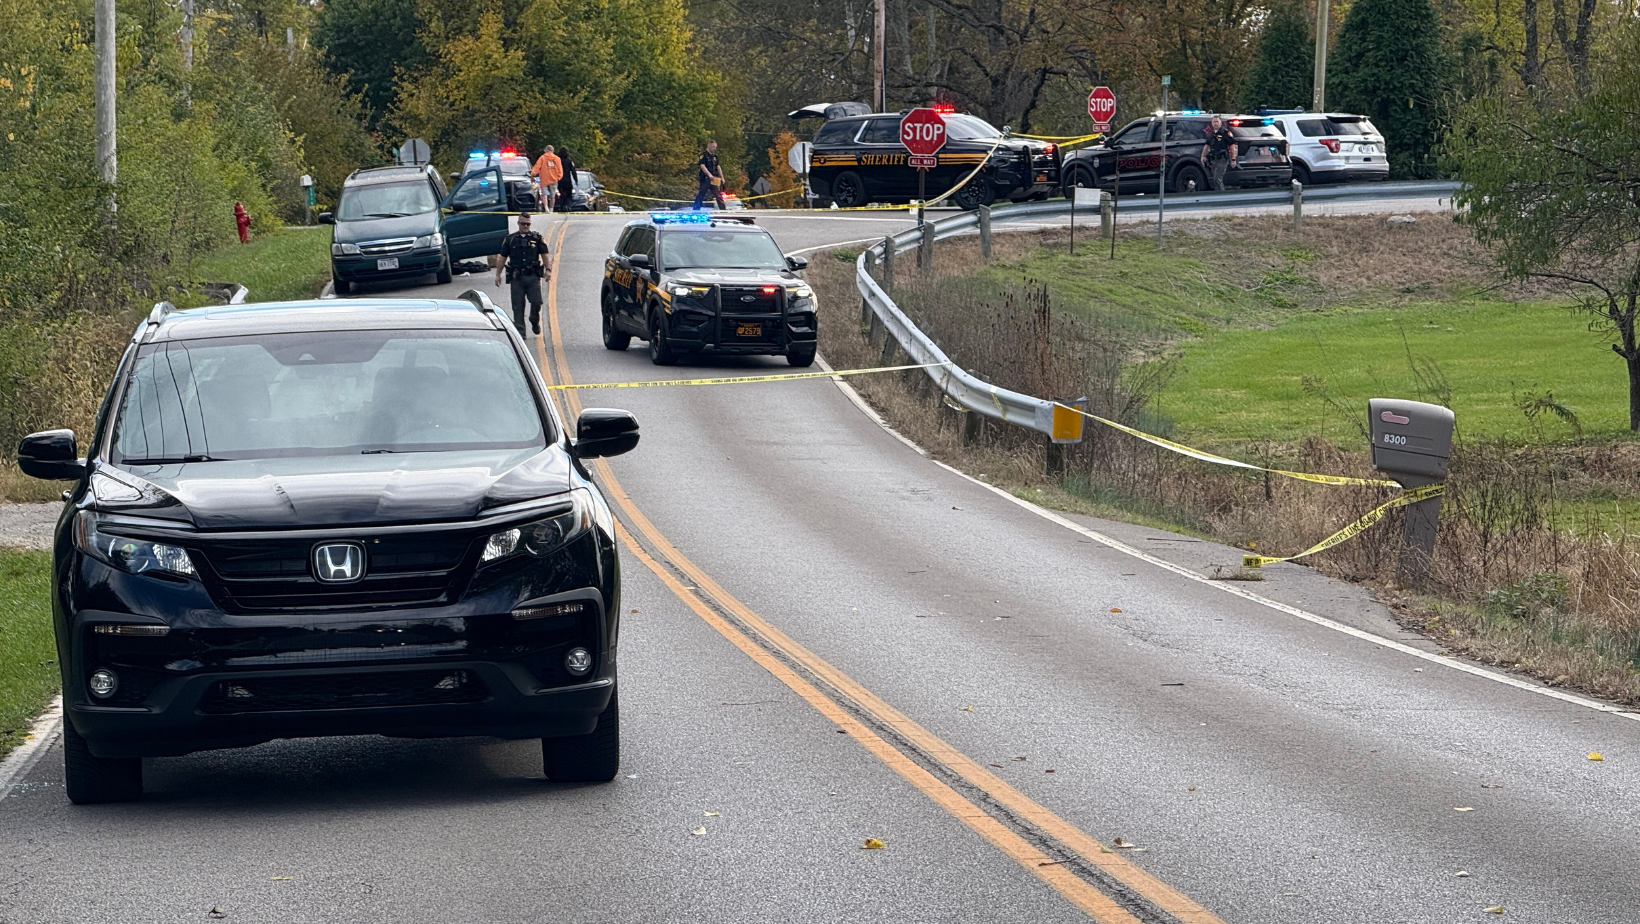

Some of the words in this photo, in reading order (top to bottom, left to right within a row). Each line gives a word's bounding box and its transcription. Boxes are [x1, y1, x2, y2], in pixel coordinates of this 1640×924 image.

[1091, 99, 1113, 112] STOP
[904, 124, 943, 141] STOP
[862, 154, 906, 165] SHERIFF
[1384, 433, 1407, 446] 8300
